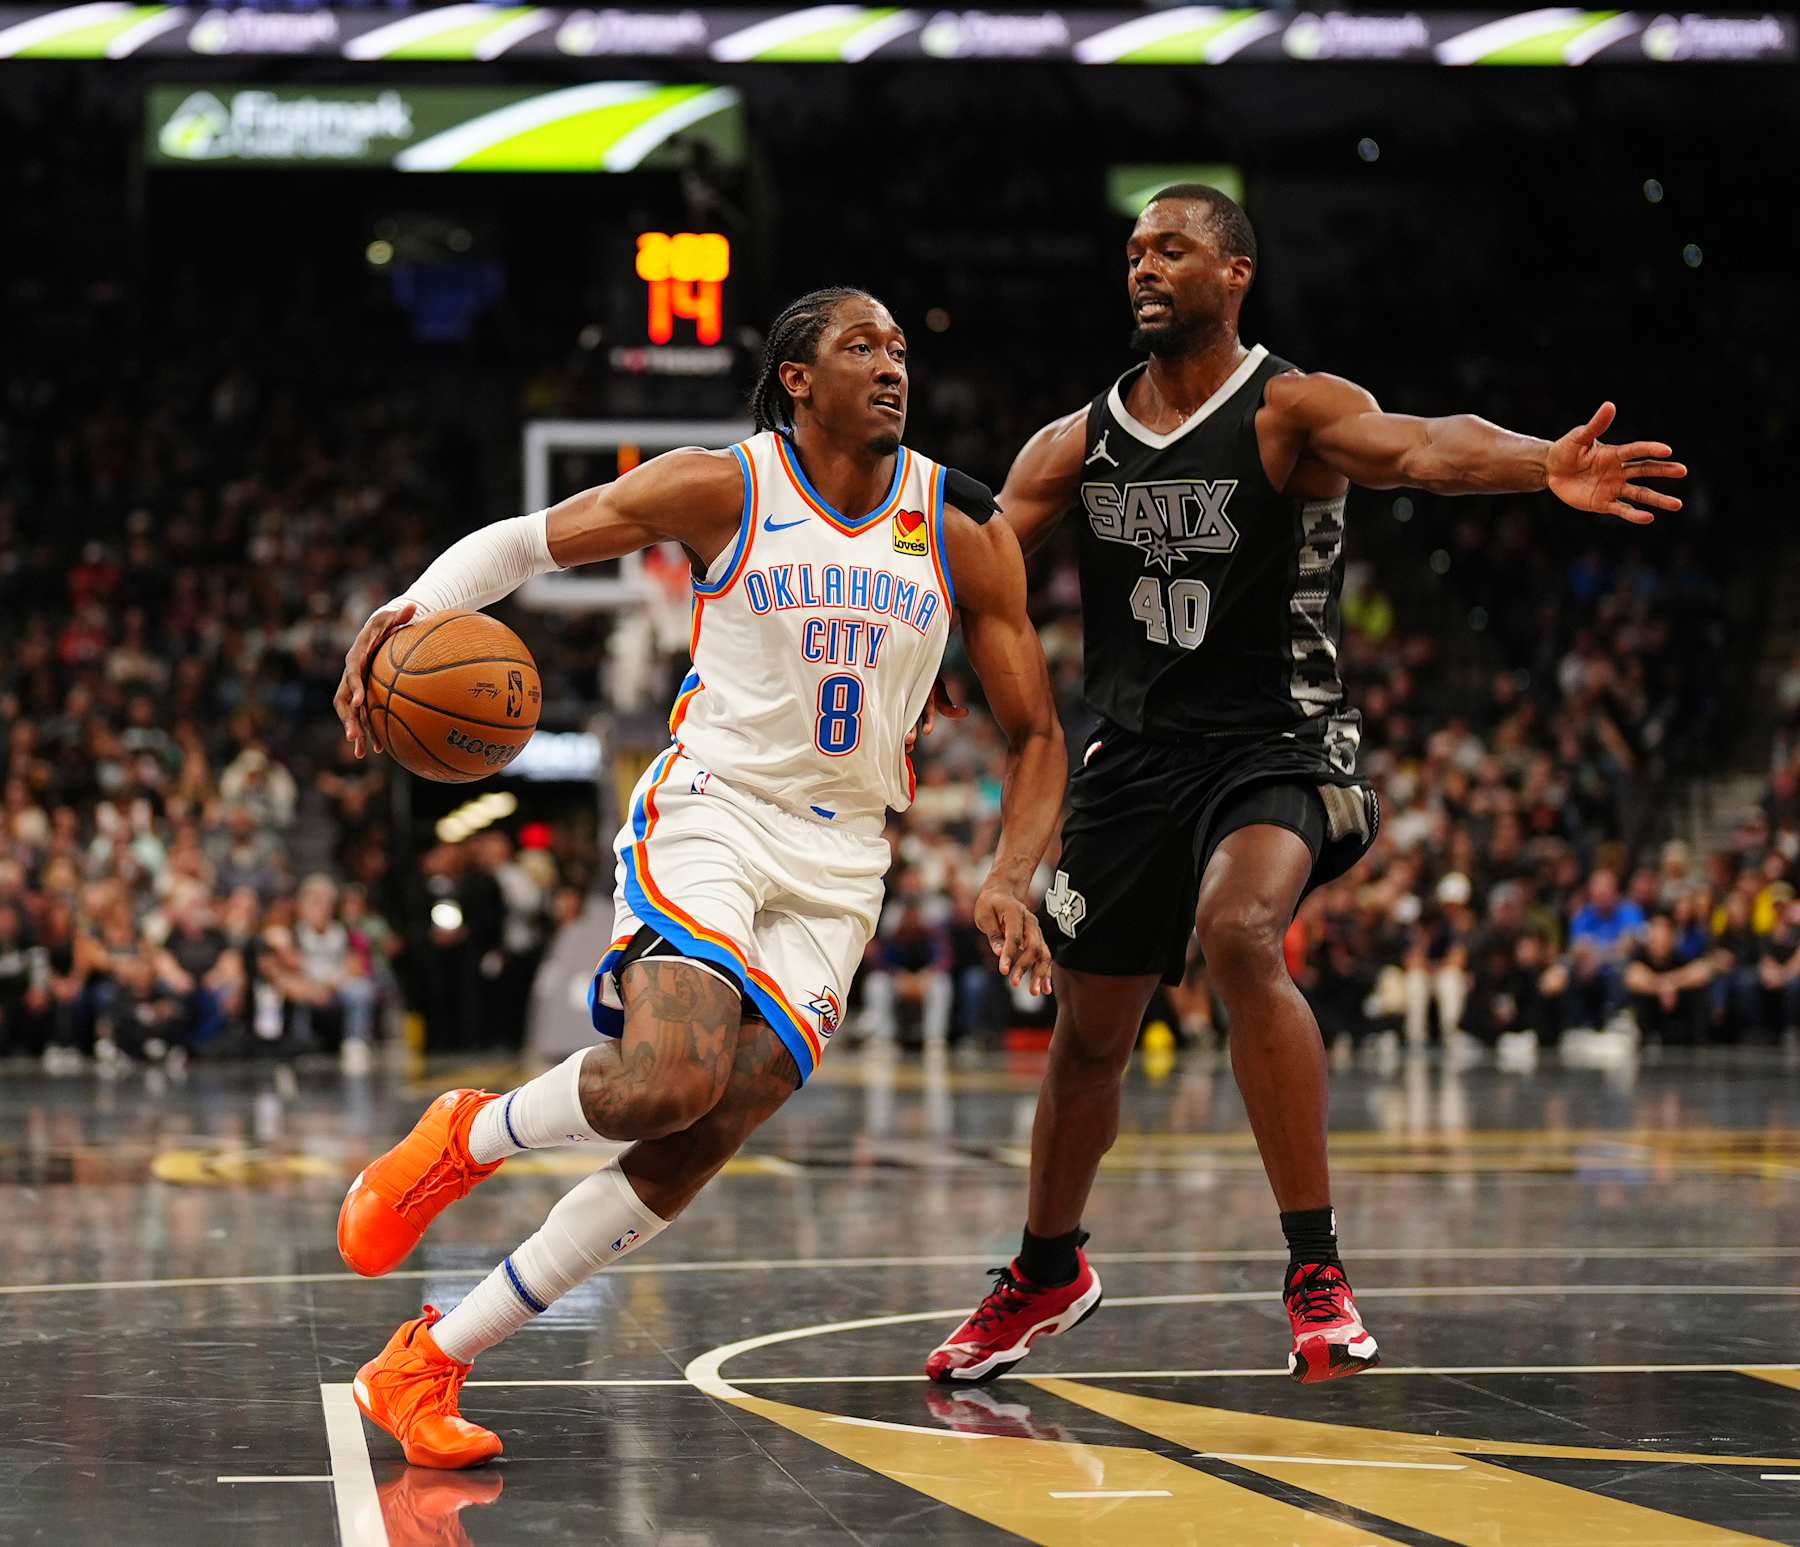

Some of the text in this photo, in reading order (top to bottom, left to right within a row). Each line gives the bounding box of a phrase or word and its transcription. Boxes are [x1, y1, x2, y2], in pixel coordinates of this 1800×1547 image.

[648, 278, 722, 346] 14
[1081, 480, 1240, 554] SATX
[744, 563, 940, 635] OKLAHOMA
[1129, 576, 1211, 650] 40
[802, 617, 889, 668] CITY
[815, 672, 864, 757] 8
